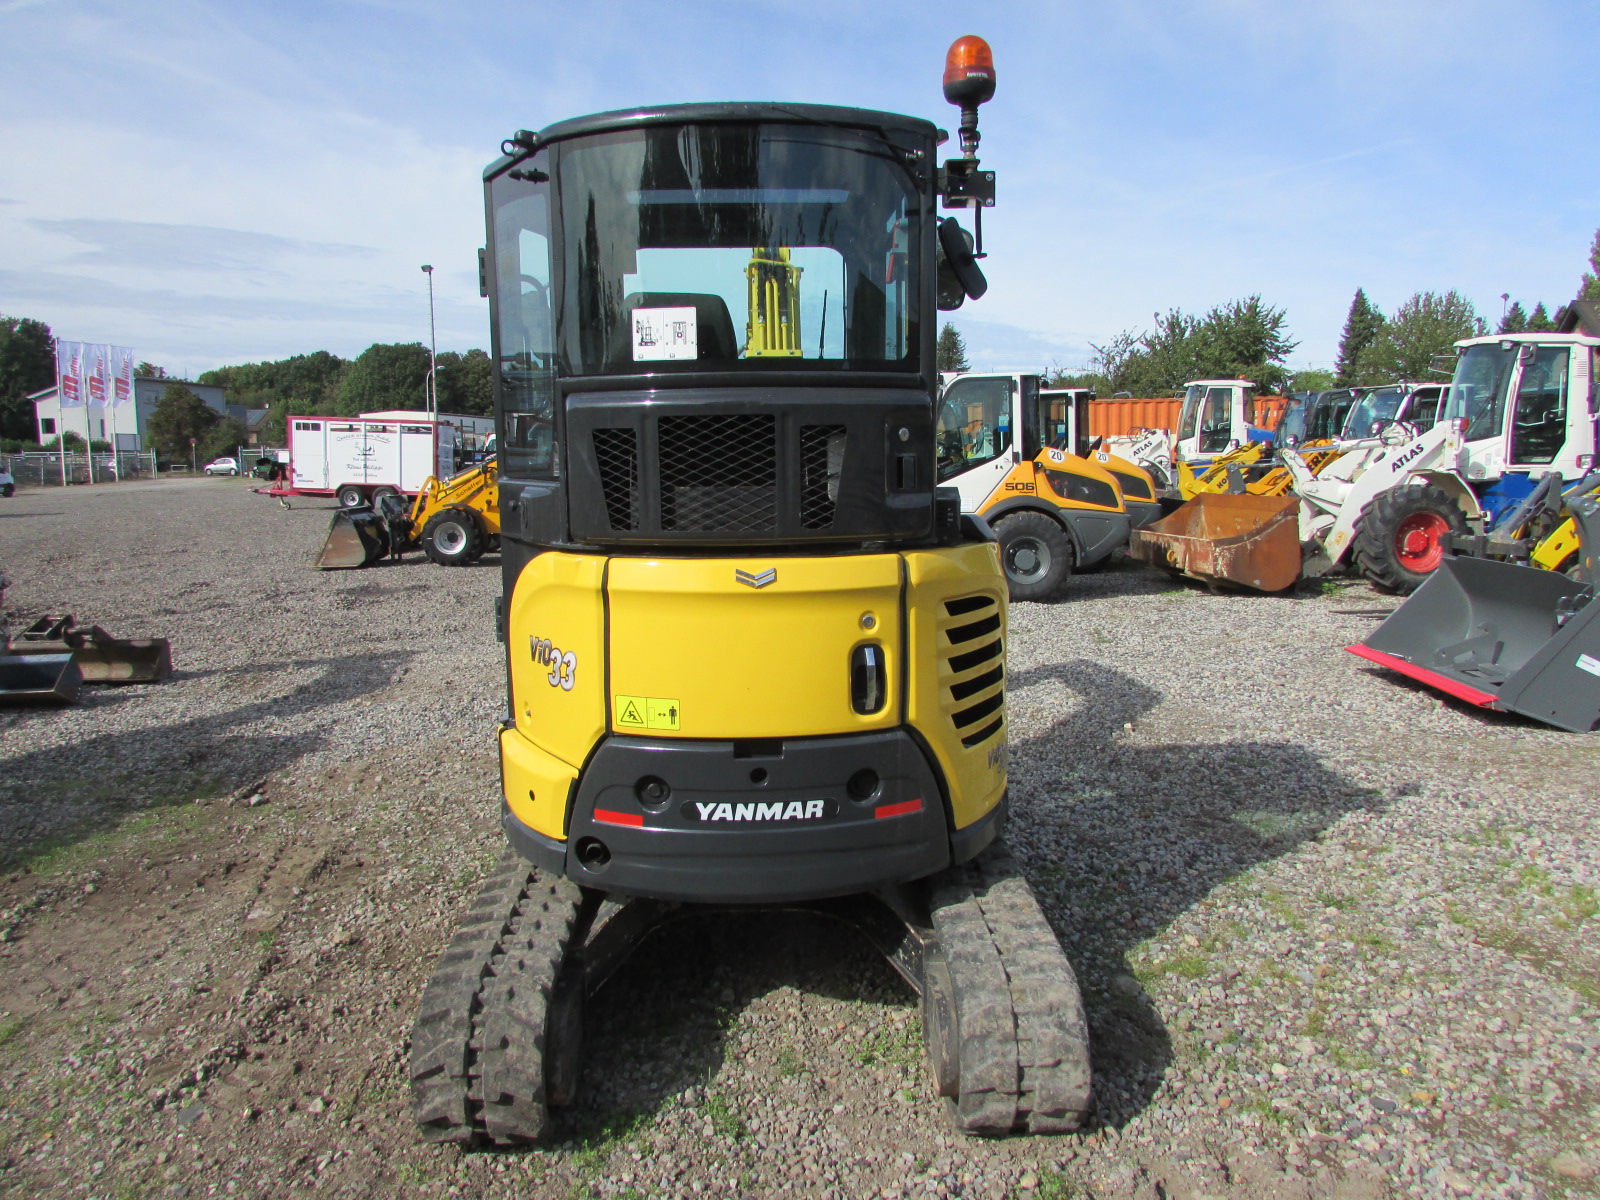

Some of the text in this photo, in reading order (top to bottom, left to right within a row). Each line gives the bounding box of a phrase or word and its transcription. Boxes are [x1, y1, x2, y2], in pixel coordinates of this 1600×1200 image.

[1051, 450, 1063, 461] 20
[1132, 440, 1153, 457] ATLAS
[1097, 452, 1108, 462] 20
[1391, 443, 1424, 473] ATLAS
[1005, 482, 1035, 491] 506
[695, 799, 825, 821] YANMAR
